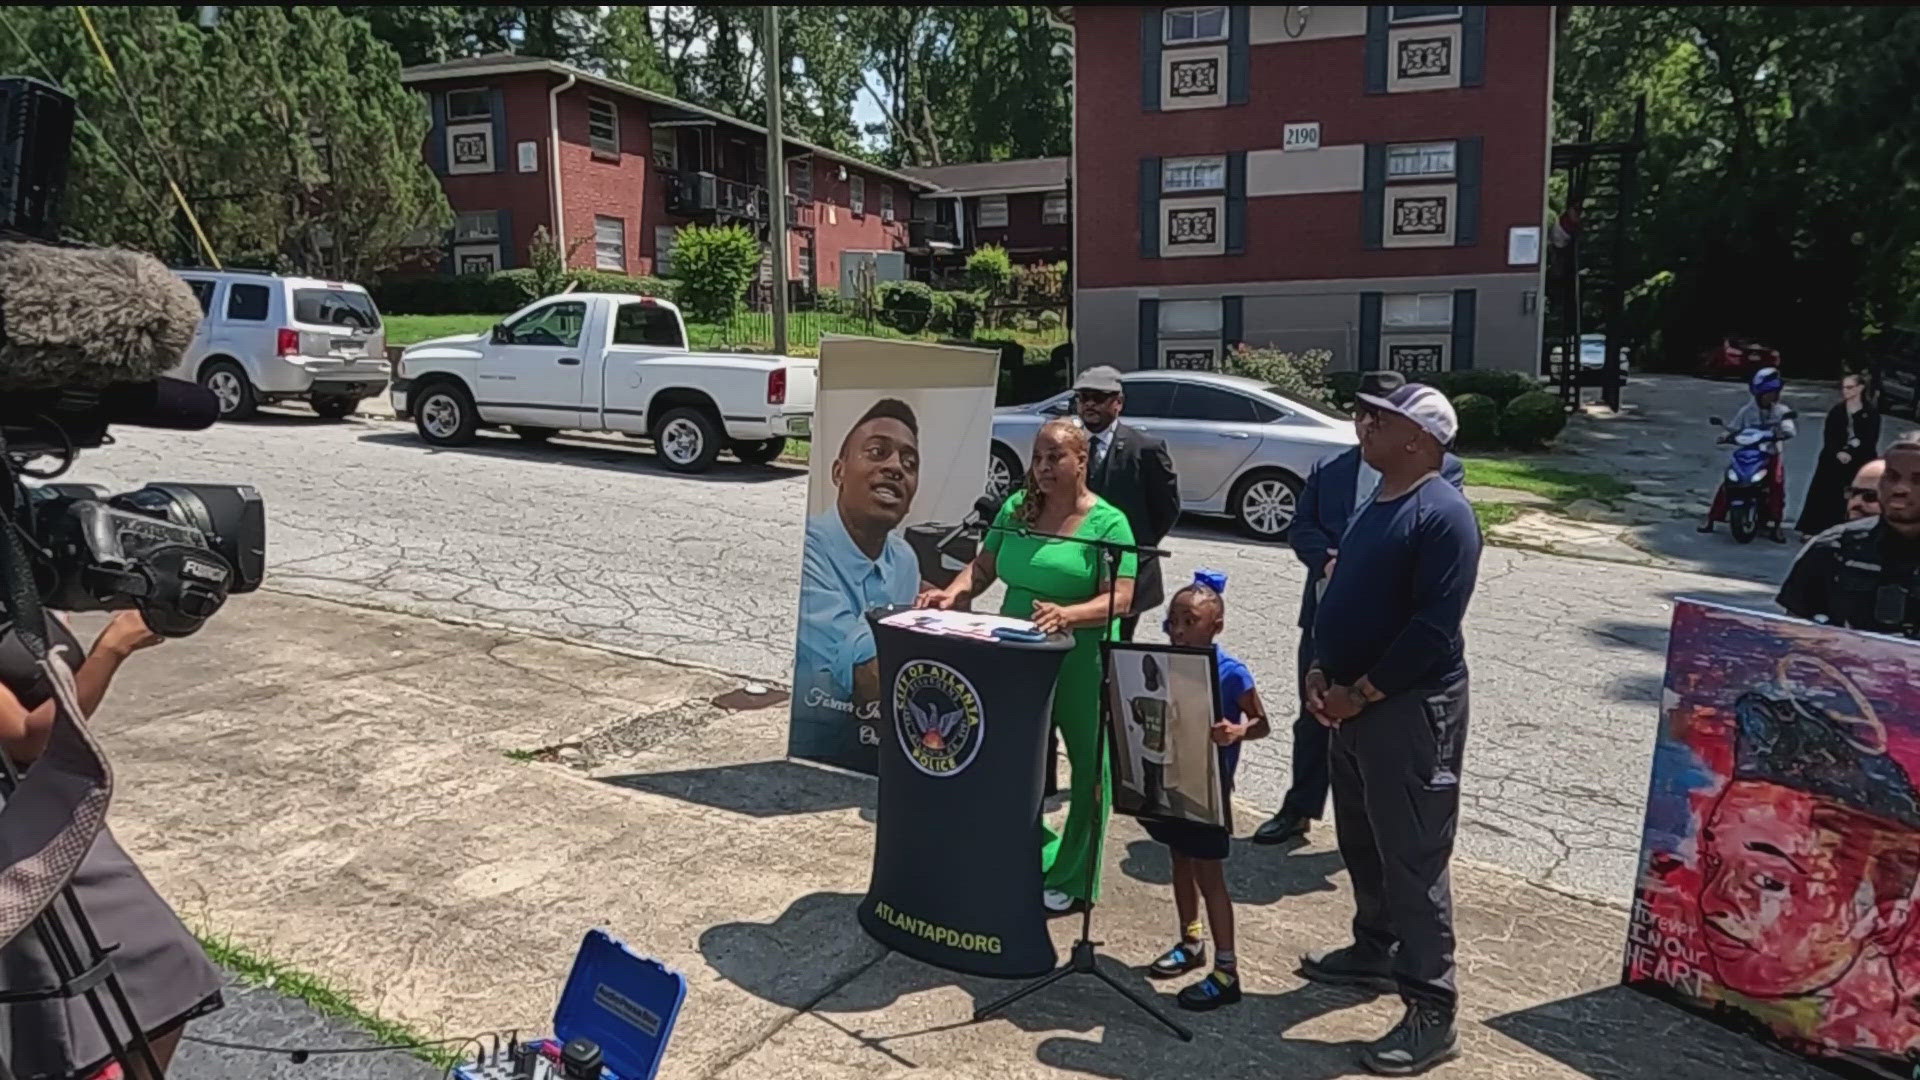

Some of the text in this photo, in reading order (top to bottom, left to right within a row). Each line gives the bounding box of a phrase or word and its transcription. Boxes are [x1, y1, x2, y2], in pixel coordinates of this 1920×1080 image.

[1286, 128, 1317, 145] 2190
[897, 664, 979, 726] CITY OF ATLANTA
[912, 748, 956, 771] POLICE
[874, 901, 1002, 954] ATLANTAPD.ORG
[1629, 922, 1662, 948] IN
[1626, 941, 1714, 998] HEART
